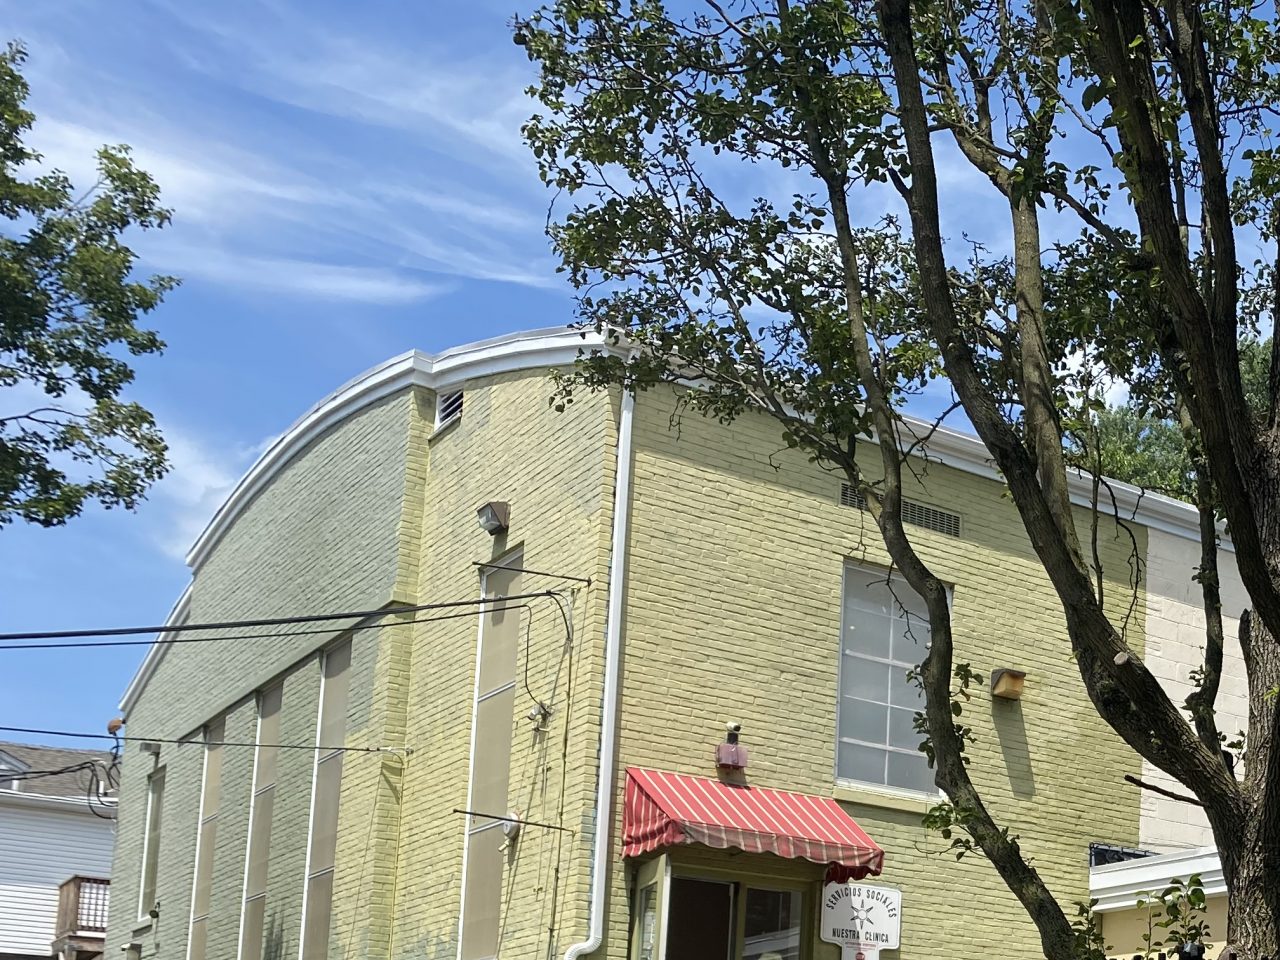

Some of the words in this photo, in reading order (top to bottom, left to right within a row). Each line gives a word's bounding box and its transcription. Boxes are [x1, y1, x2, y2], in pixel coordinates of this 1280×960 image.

[825, 887, 862, 910] SERVICIOS
[866, 889, 897, 918] SOCIALES
[832, 928, 860, 940] NUESTRA
